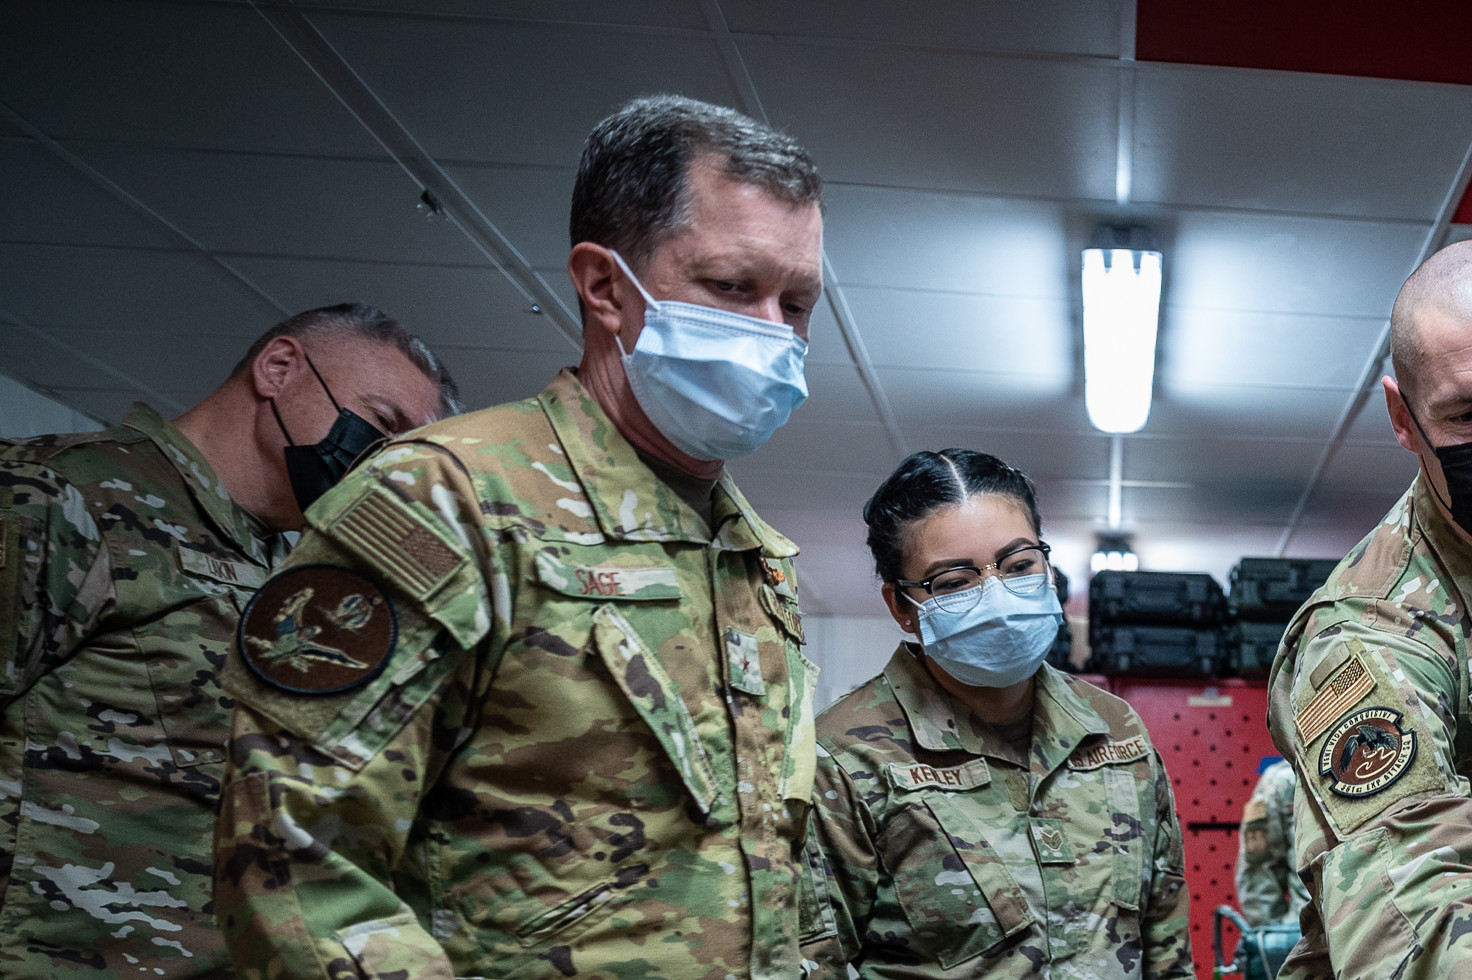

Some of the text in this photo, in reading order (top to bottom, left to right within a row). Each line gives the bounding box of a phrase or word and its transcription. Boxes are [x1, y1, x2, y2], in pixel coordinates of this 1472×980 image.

[205, 556, 238, 581] LAKIN
[573, 569, 626, 597] SAGE
[1329, 730, 1343, 746] VIDI
[1087, 746, 1110, 766] AIR
[1108, 739, 1147, 761] FORCE
[1366, 780, 1381, 791] EXP
[1383, 754, 1408, 781] ATTACK
